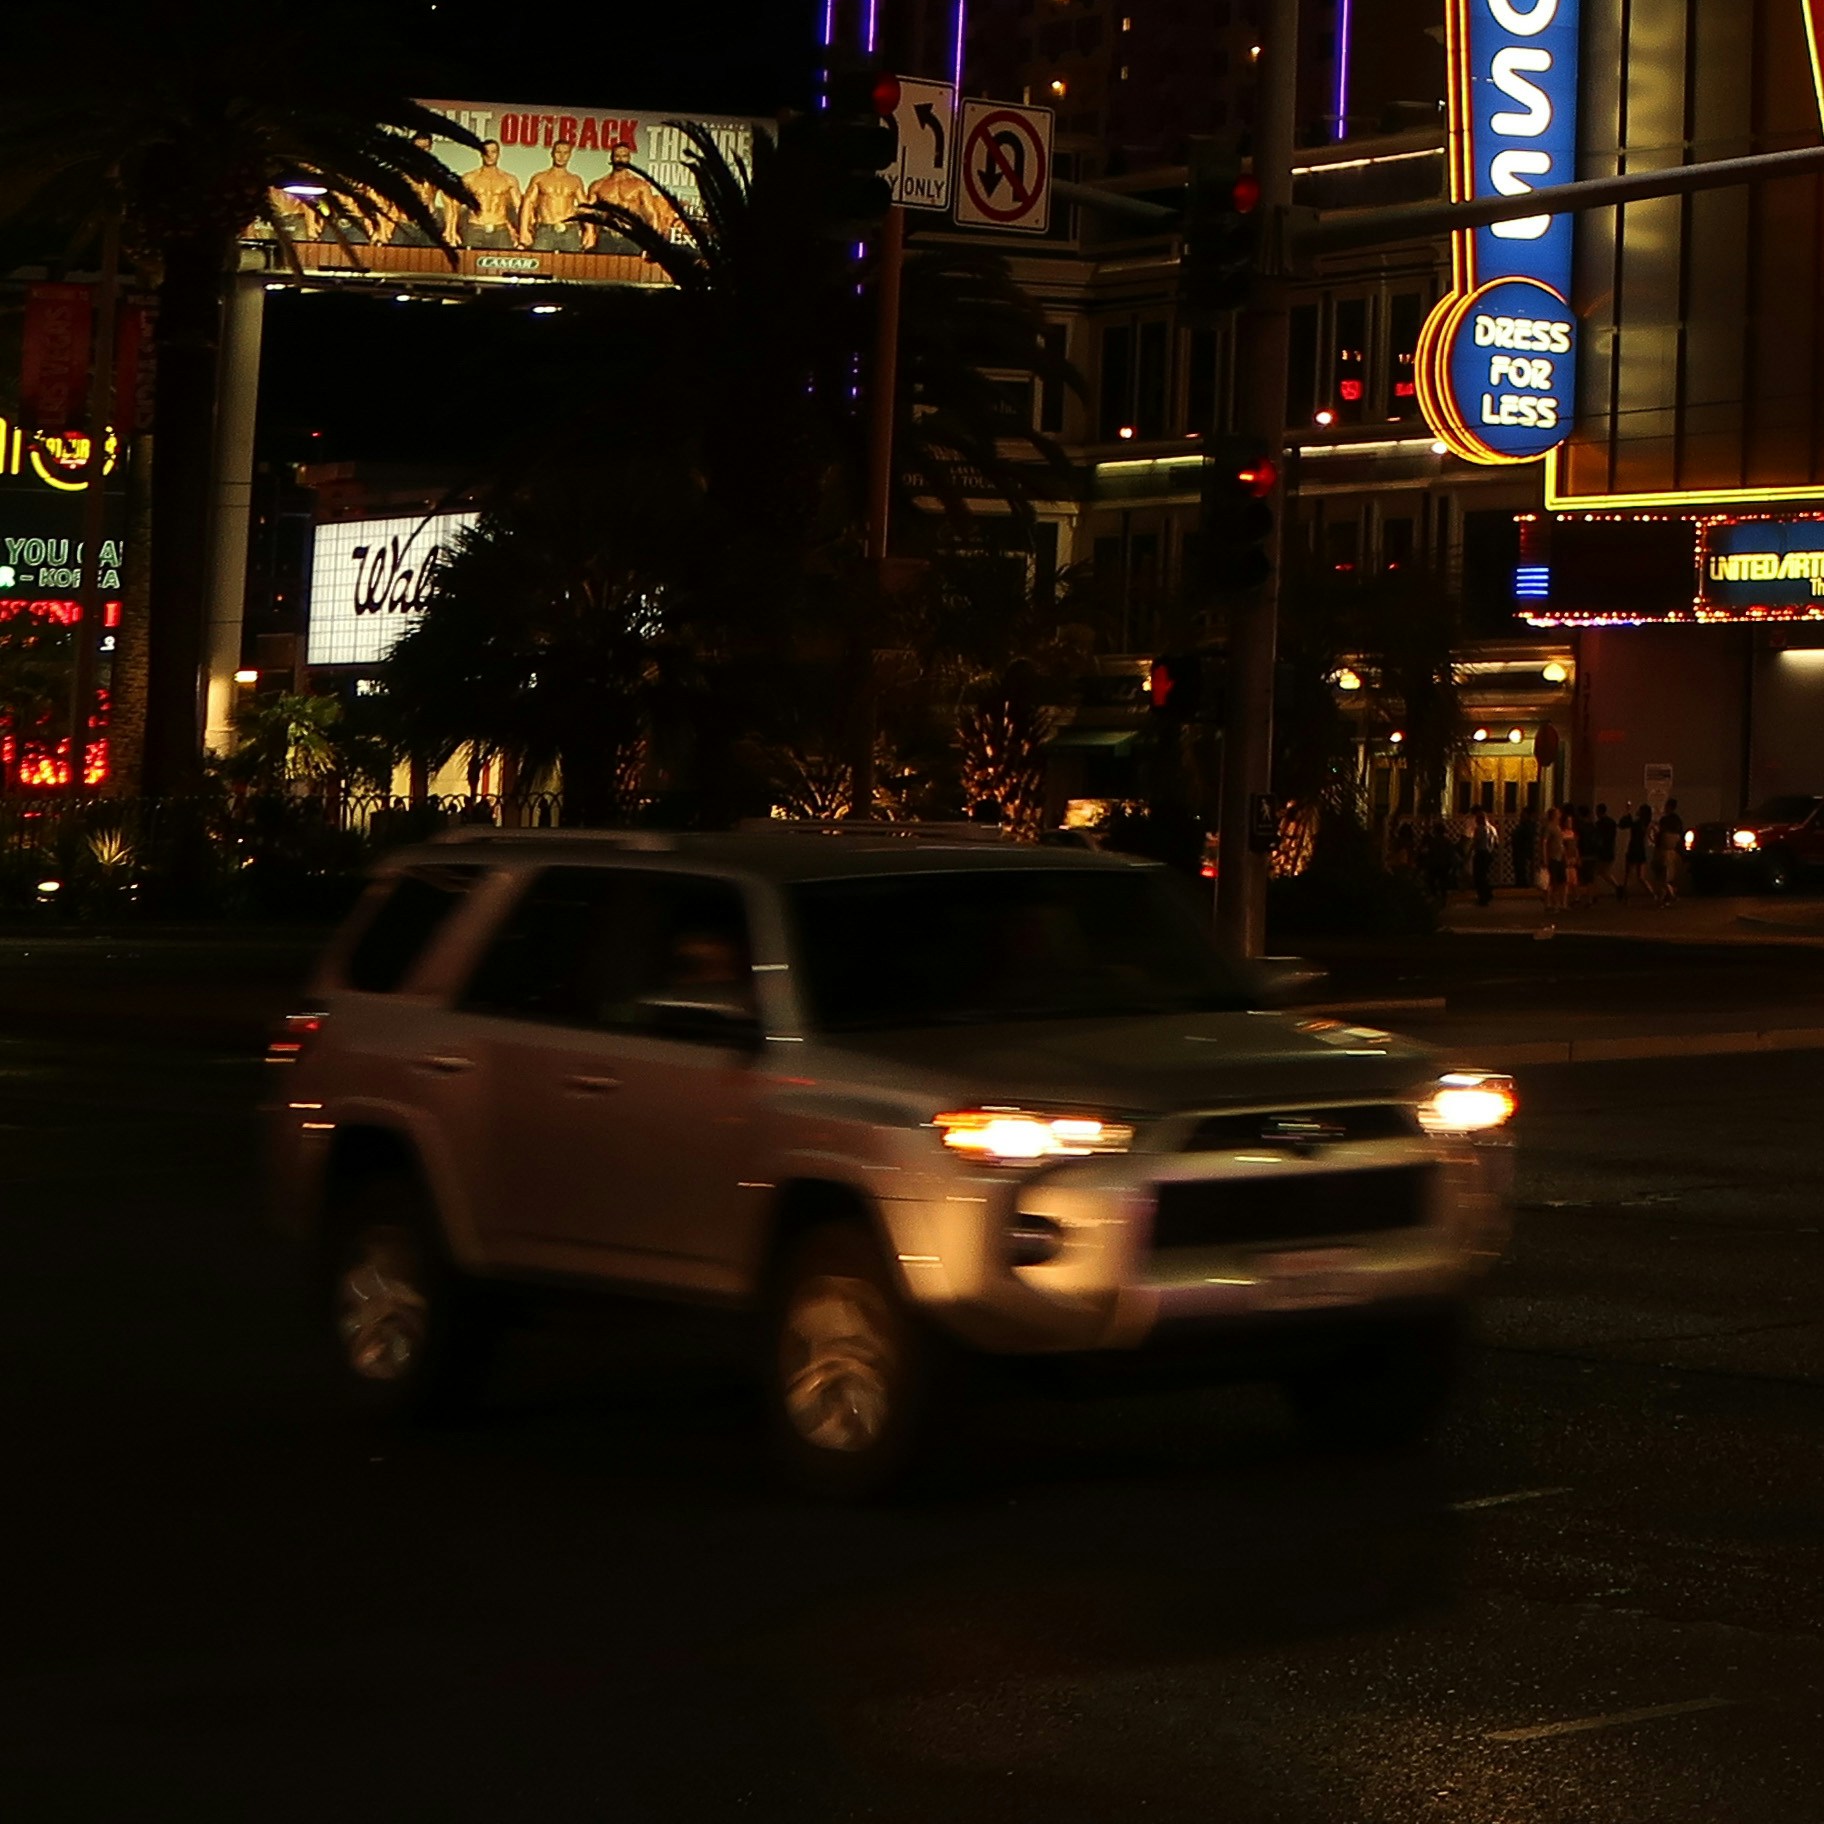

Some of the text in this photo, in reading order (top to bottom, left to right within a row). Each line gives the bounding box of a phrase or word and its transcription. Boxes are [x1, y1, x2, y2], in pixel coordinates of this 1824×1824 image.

[501, 112, 638, 153] OUTBACK
[904, 176, 944, 199] ONLY
[1475, 315, 1570, 354] DRESS
[1490, 356, 1552, 390] FOR
[1481, 393, 1558, 429] LESS
[4, 537, 69, 567] YOU
[39, 567, 121, 589] KOA
